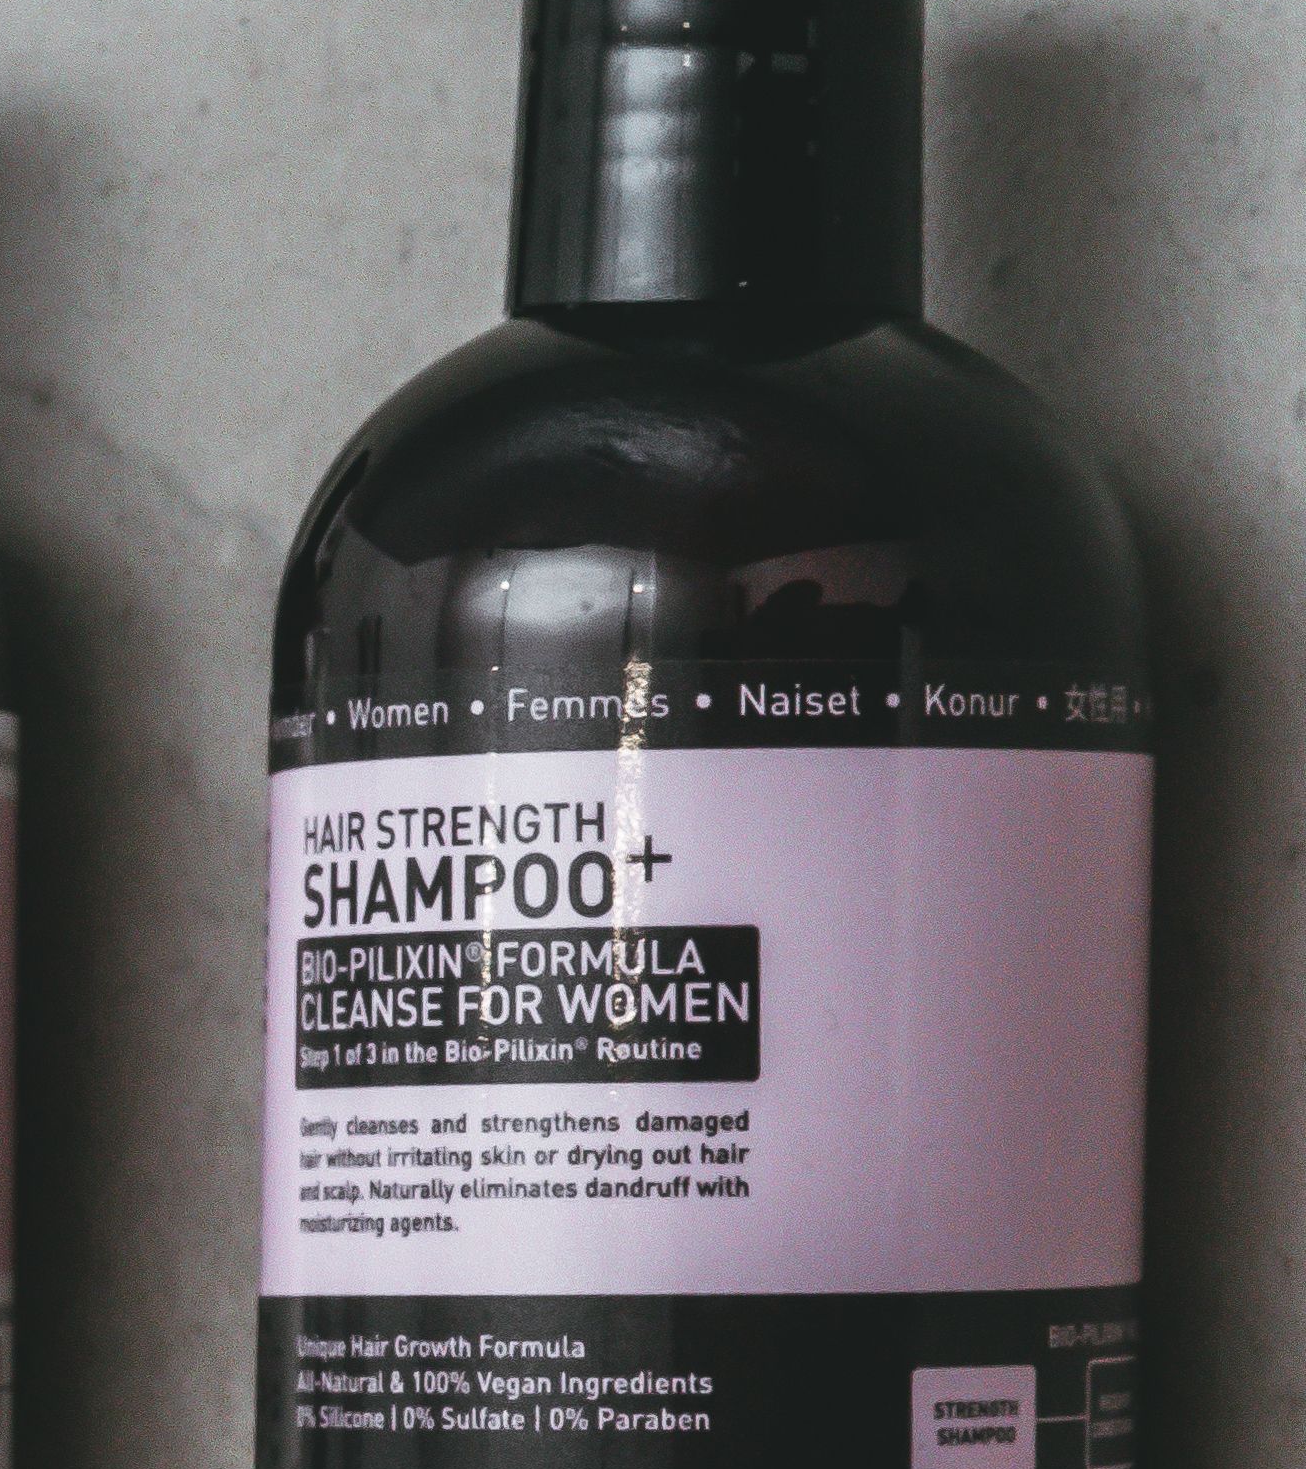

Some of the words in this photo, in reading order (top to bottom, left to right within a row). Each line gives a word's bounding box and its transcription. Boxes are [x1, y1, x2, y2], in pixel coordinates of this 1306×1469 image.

[347, 697, 448, 731] Women
[506, 688, 670, 723] Femmes
[738, 683, 861, 718] Naiset
[923, 683, 1020, 718] Konur
[303, 810, 365, 855] HAIR
[376, 801, 605, 851] STRENGTH
[497, 938, 706, 978] FORMULA
[300, 985, 444, 1032] CLEANSE
[458, 984, 543, 1028] FOR
[558, 981, 749, 1027] WOMEN
[333, 1044, 340, 1065] 1
[345, 1043, 362, 1065] of
[367, 1042, 377, 1065] 3
[382, 1042, 400, 1065] in
[406, 1040, 438, 1064] the
[597, 1037, 702, 1062] Routine
[346, 1114, 419, 1136] cleanses
[431, 1113, 467, 1135] and
[481, 1112, 621, 1138] strengthens
[635, 1110, 750, 1137] damaged
[326, 1148, 382, 1169] without
[387, 1146, 472, 1171] irritating
[481, 1146, 526, 1167] skin
[535, 1149, 559, 1166] or
[567, 1145, 643, 1171] drying
[652, 1146, 691, 1165] out
[701, 1143, 750, 1165] hair
[369, 1180, 455, 1205] Naturally
[460, 1178, 578, 1200] eliminates
[586, 1176, 690, 1199] dandruff
[697, 1176, 750, 1198] with
[300, 1214, 385, 1238] moisturizing
[389, 1213, 459, 1238] agents.
[351, 1335, 389, 1359] Hair
[395, 1334, 472, 1359] Growth
[479, 1334, 587, 1359] Formula
[296, 1370, 384, 1394] All-Natural
[389, 1371, 405, 1395] &
[413, 1371, 471, 1395] 100%
[477, 1371, 551, 1401] Vegan
[560, 1370, 714, 1401] Ingredients
[319, 1405, 385, 1430] Silicone
[403, 1406, 435, 1430] 0%
[441, 1406, 526, 1431] Sulfate
[550, 1407, 589, 1431] 0%
[598, 1406, 710, 1431] Paraben
[933, 1398, 1019, 1420] STRENGTH
[937, 1426, 1017, 1447] SHAMPOO
